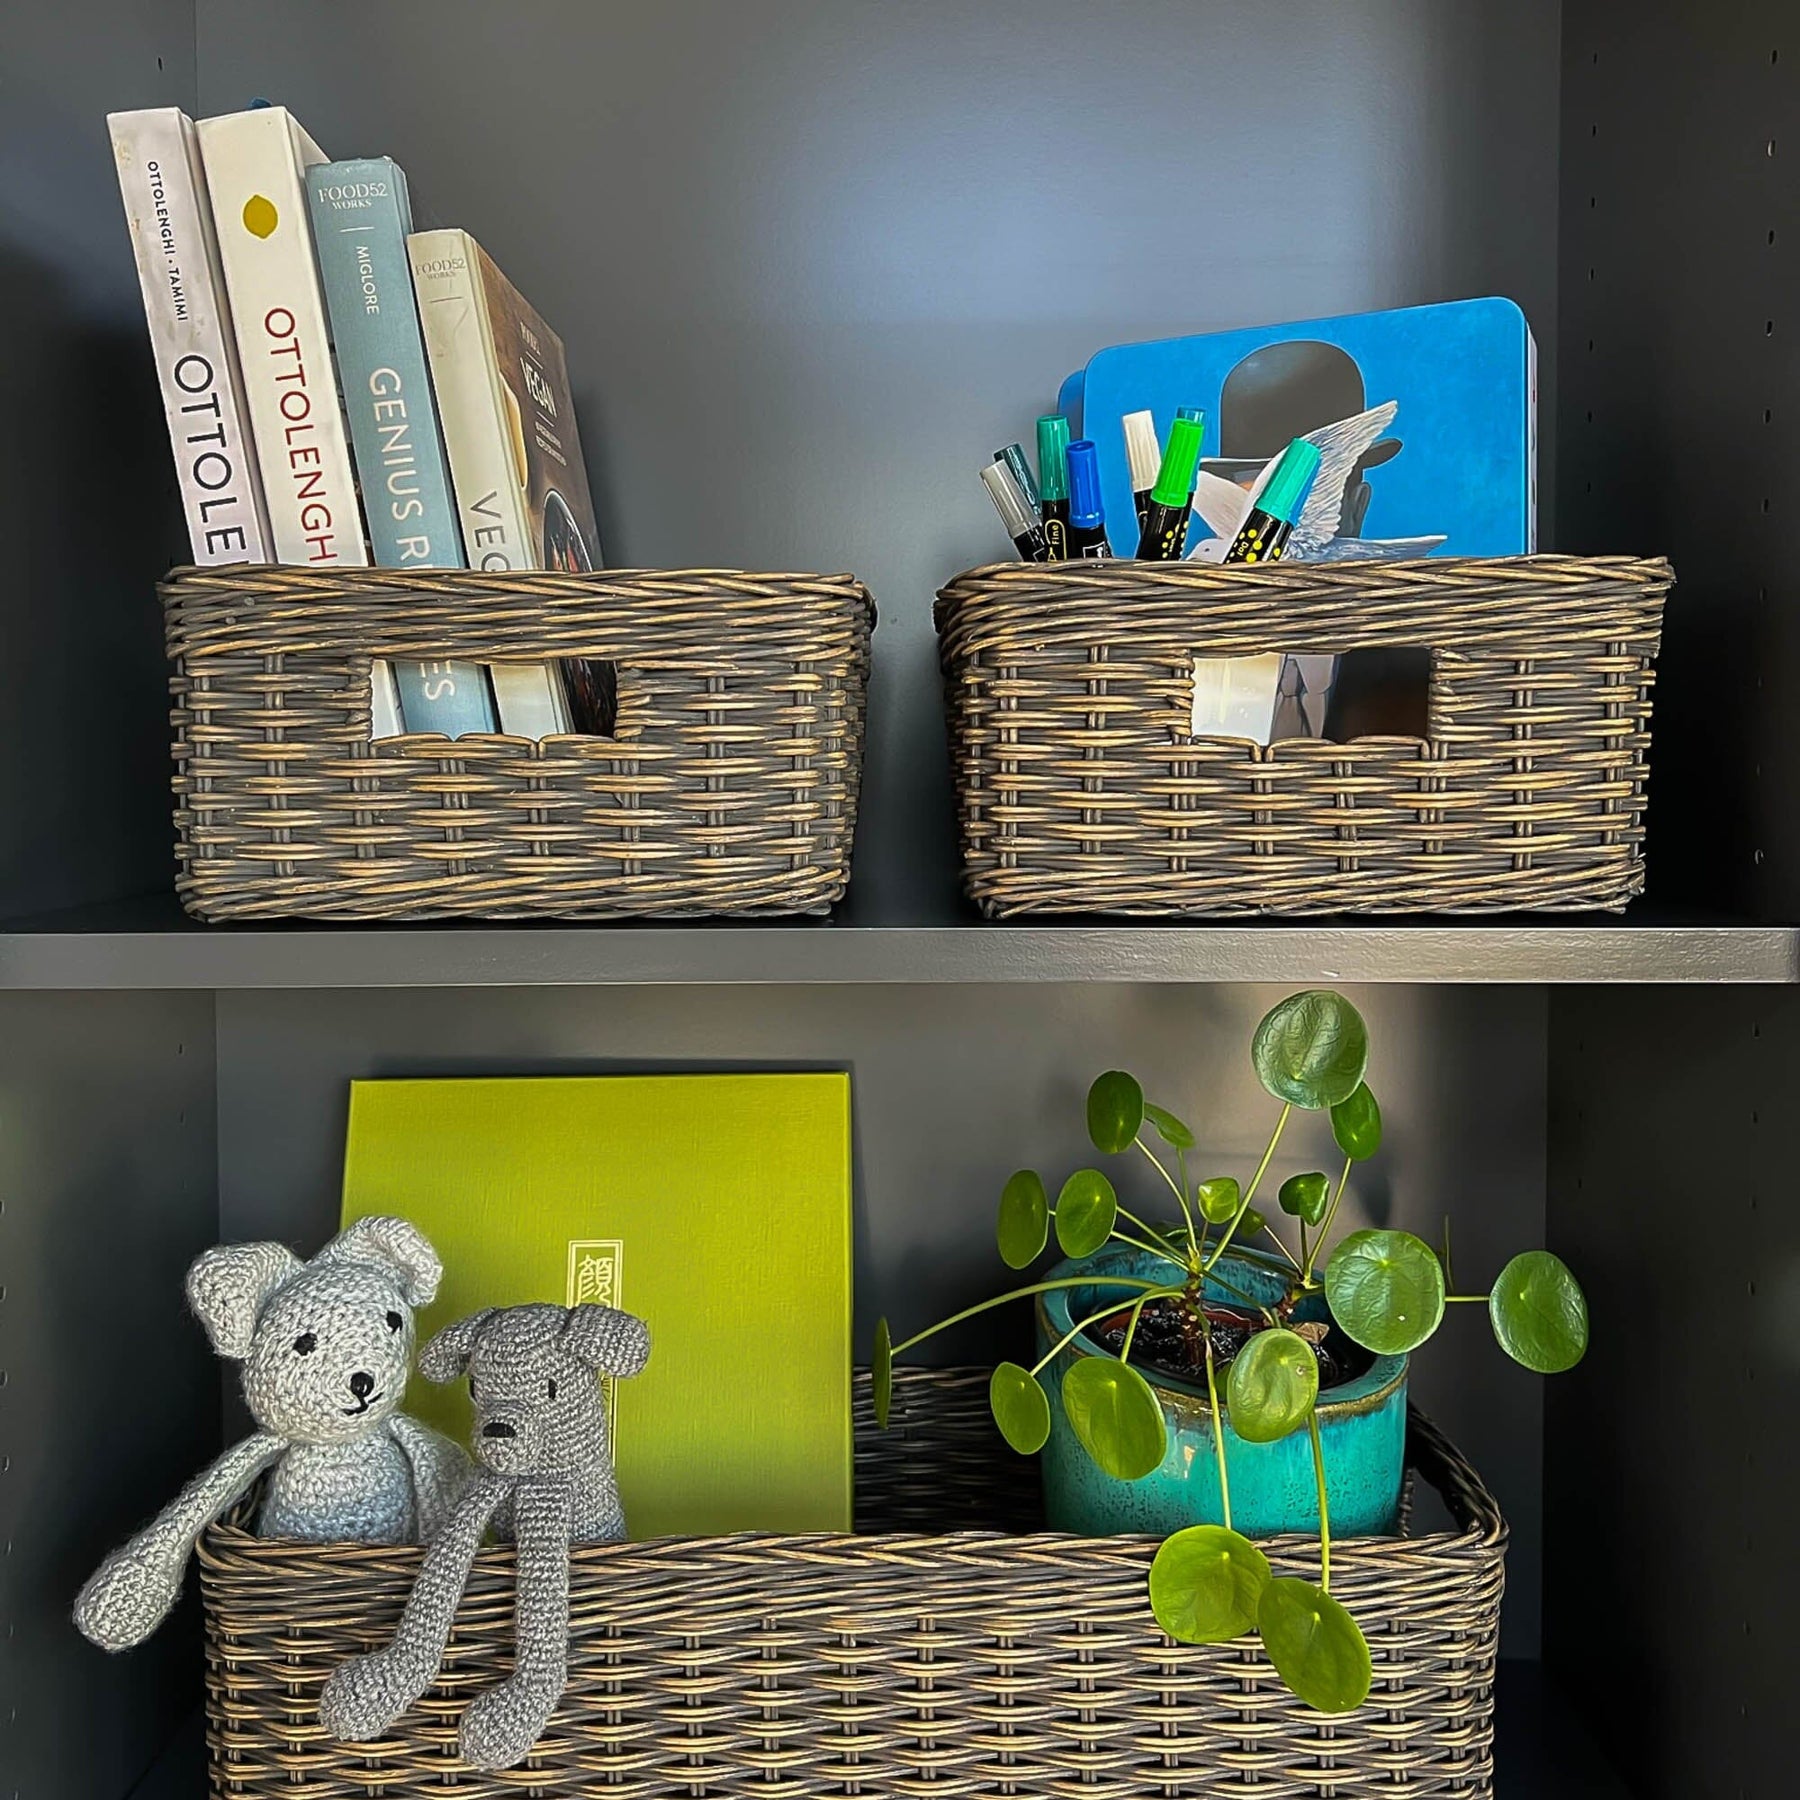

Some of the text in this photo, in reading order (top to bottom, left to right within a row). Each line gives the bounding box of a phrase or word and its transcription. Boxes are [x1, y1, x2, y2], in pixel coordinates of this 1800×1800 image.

[318, 182, 388, 203] FOOD52
[332, 198, 372, 210] WORKS
[147, 161, 176, 255] OTTOLENGHI
[168, 267, 188, 321] TAMIMI
[415, 258, 466, 276] FOOD52
[355, 246, 380, 315] MIGLORE
[174, 355, 250, 565] OTTOLE
[369, 367, 423, 521] GENIUS
